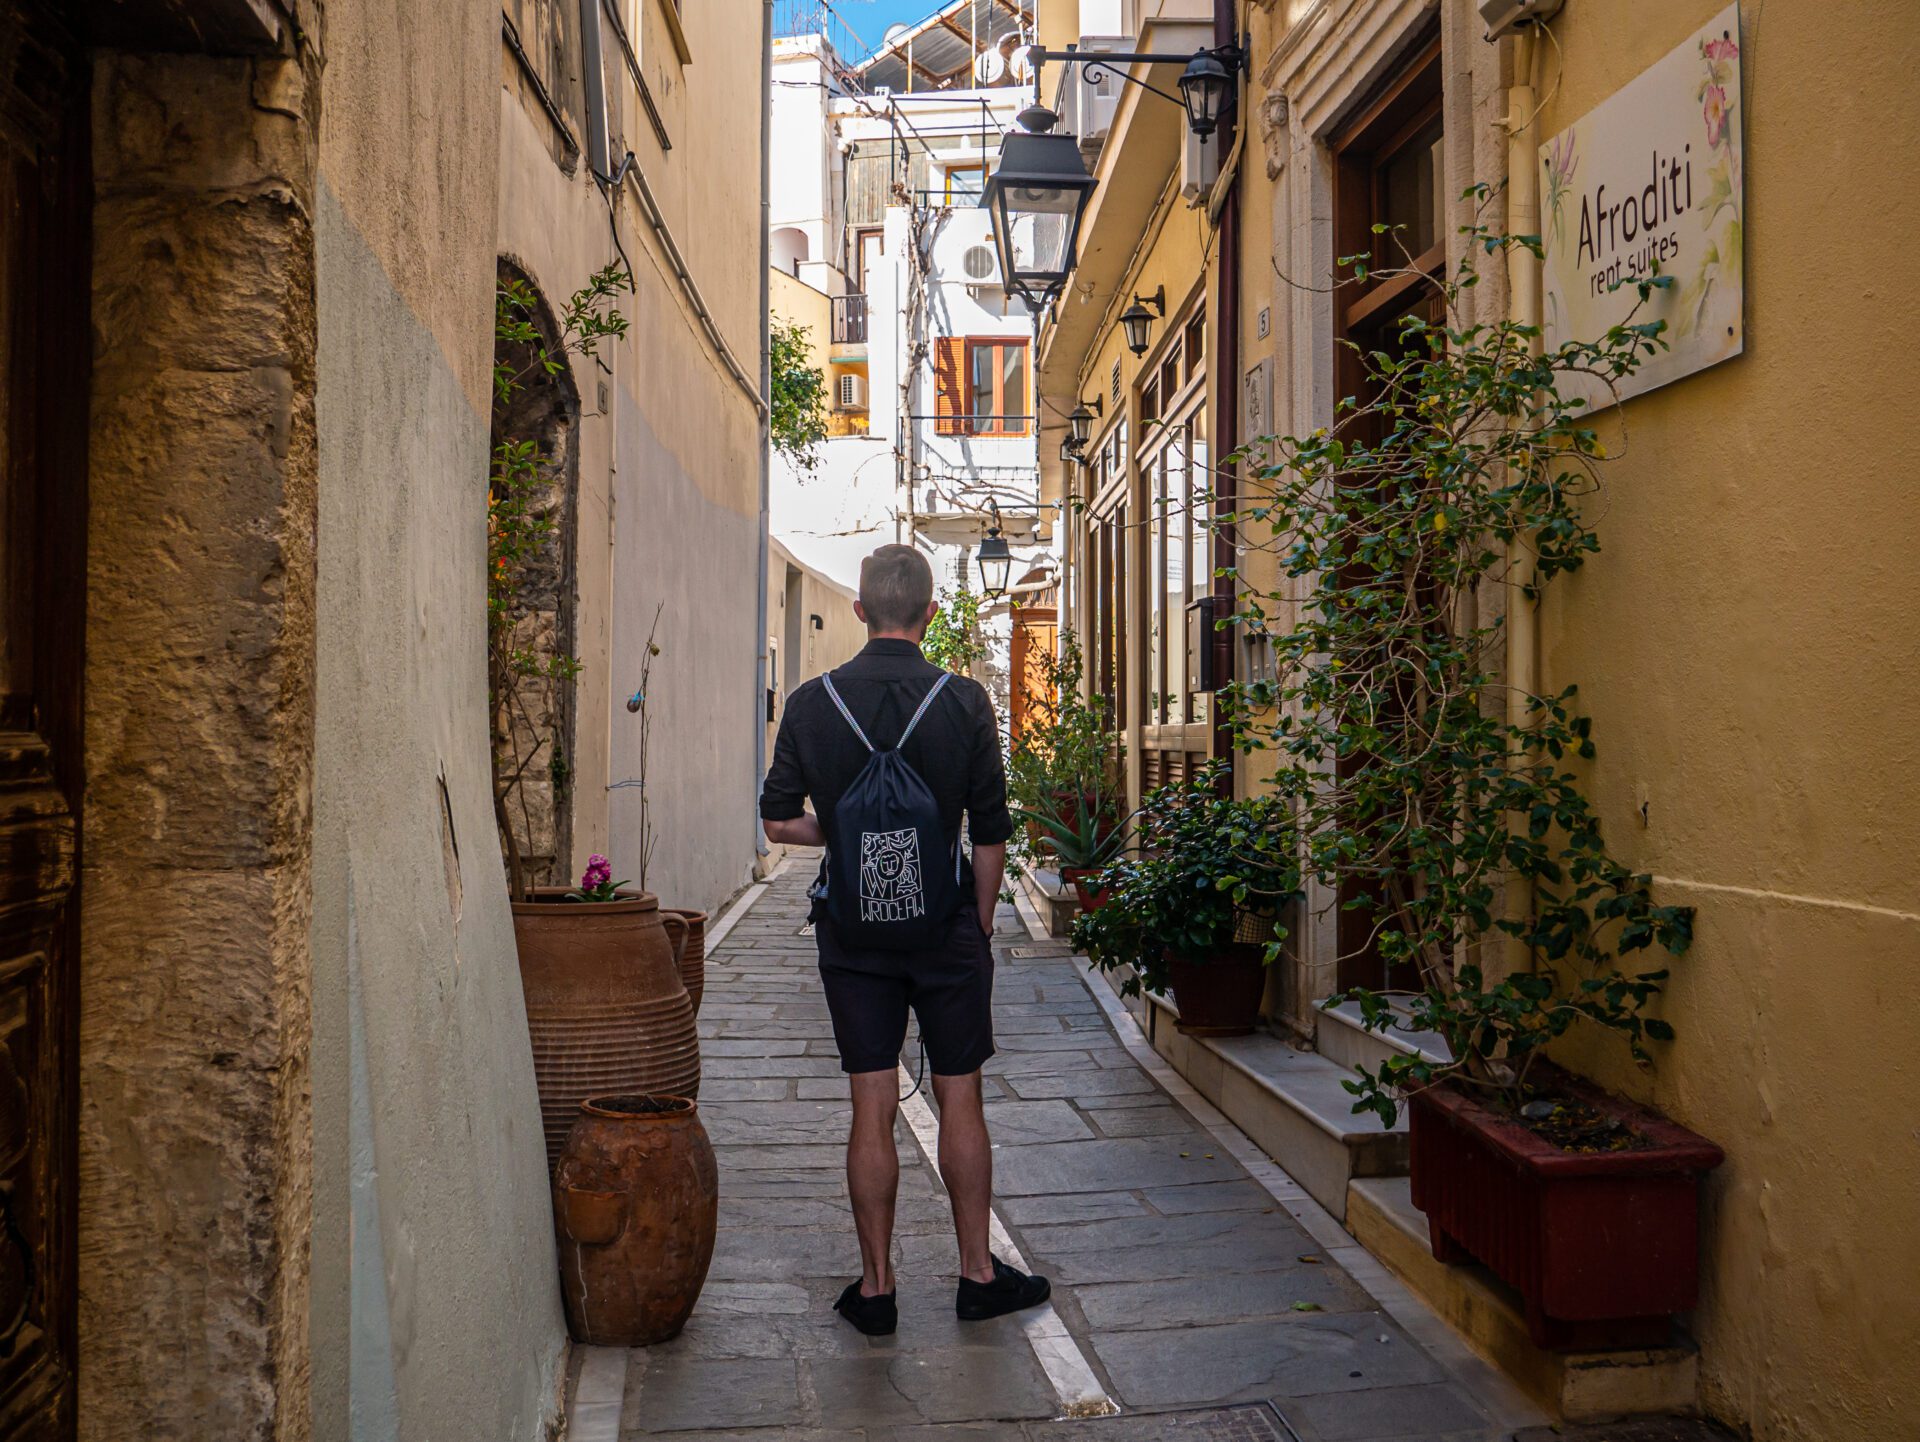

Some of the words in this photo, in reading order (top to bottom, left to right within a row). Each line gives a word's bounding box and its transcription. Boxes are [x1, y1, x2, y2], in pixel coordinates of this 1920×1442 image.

[1577, 144, 1692, 270] Afroditi
[1590, 256, 1622, 298] rent
[1628, 231, 1679, 279] suites
[860, 891, 925, 922] WROCŁAW
